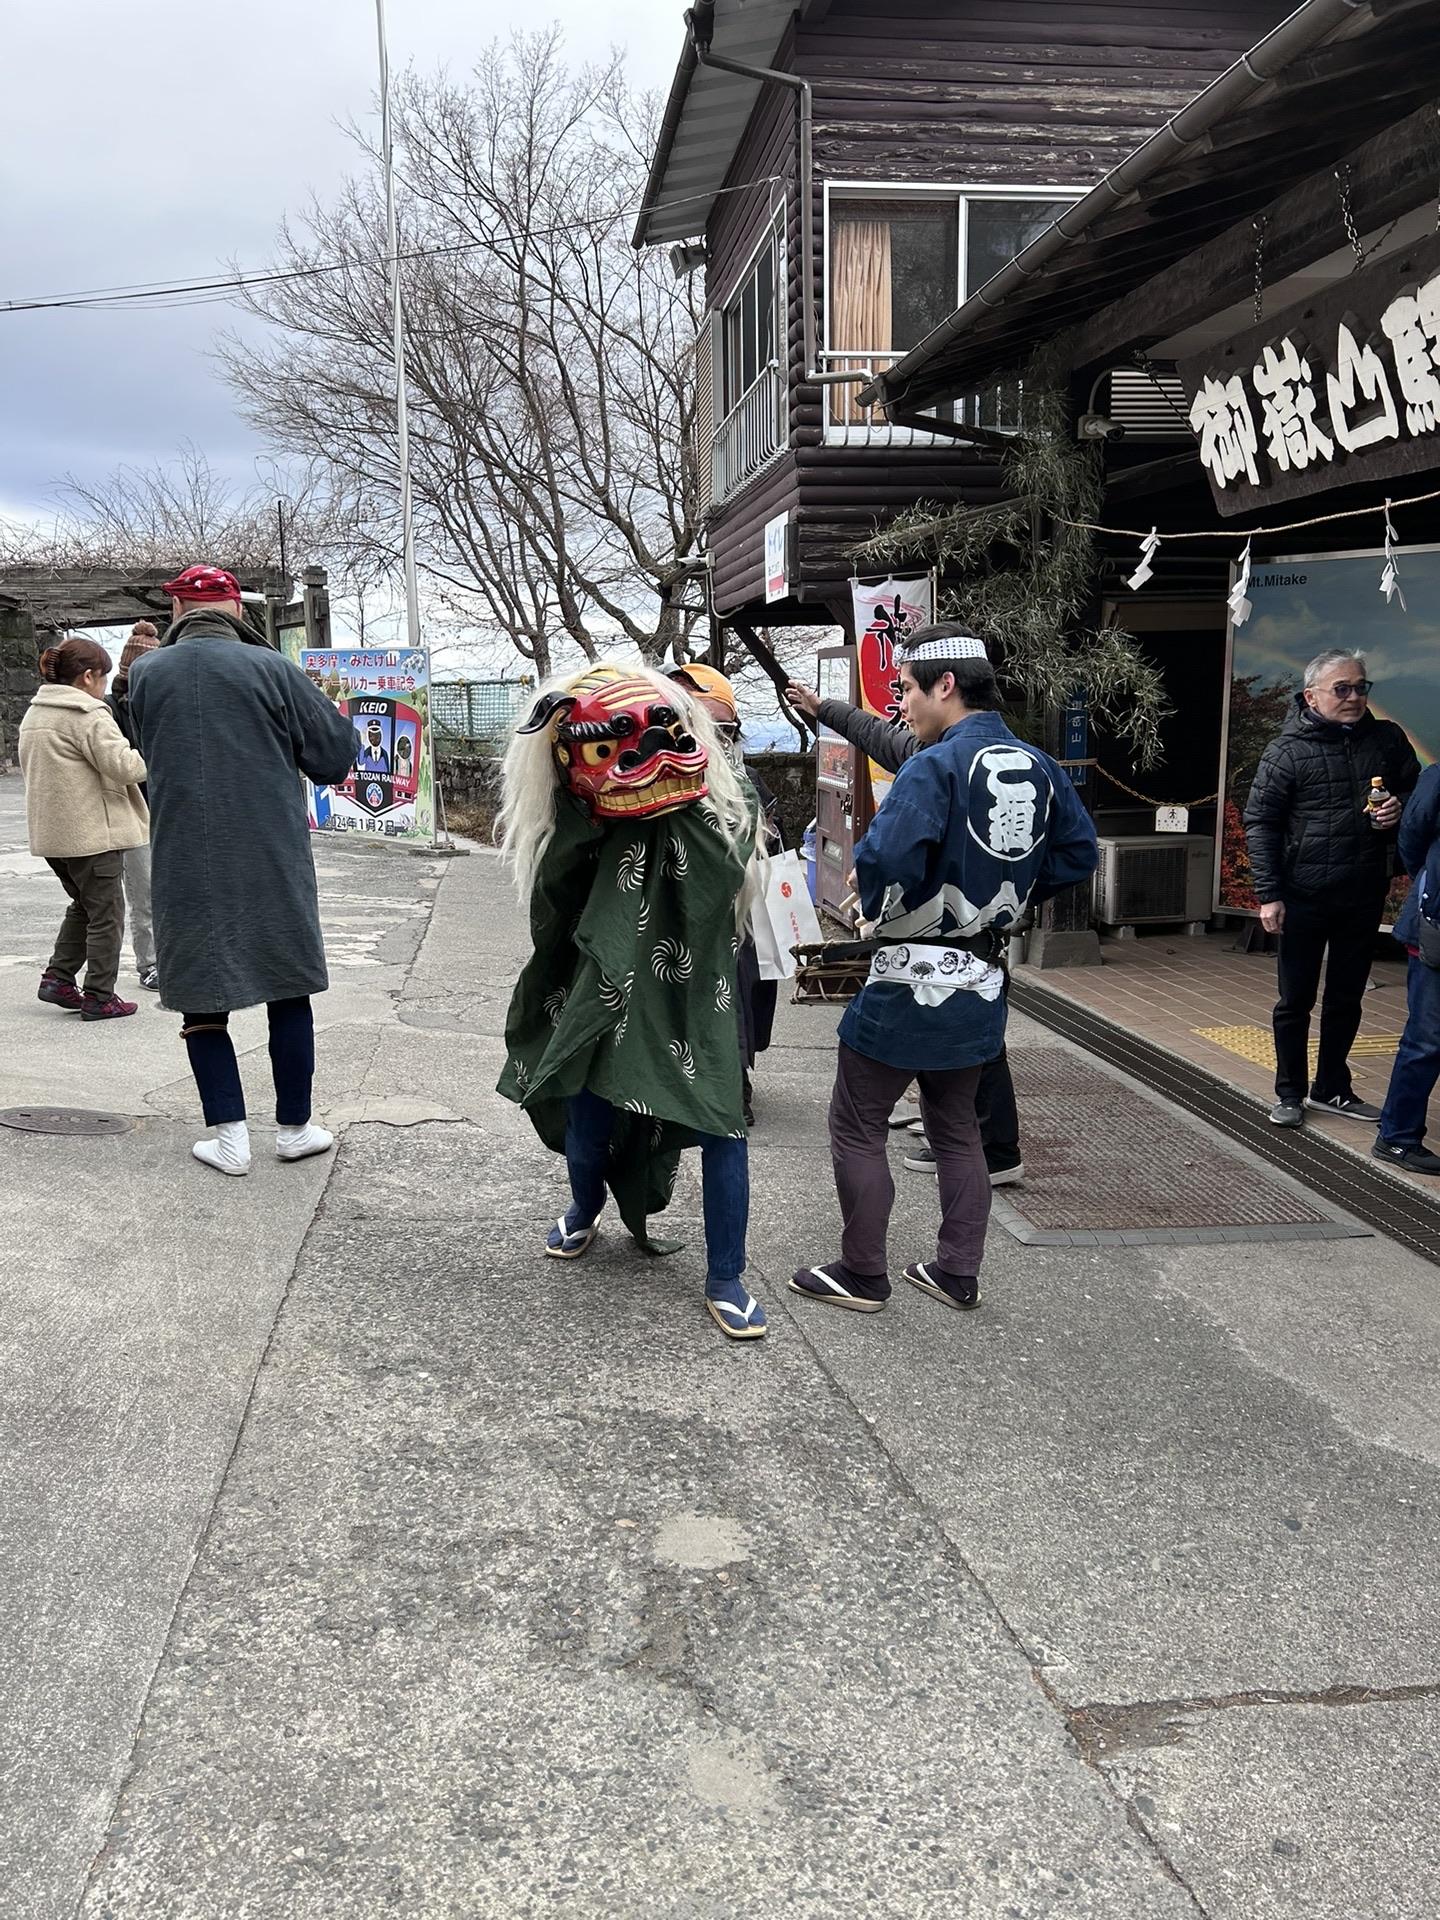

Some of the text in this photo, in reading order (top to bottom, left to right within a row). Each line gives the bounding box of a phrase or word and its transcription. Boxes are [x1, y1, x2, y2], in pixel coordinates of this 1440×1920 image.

[359, 701, 388, 714] KEIO
[360, 771, 381, 782] TOZAN
[381, 773, 410, 788] RAILWAY
